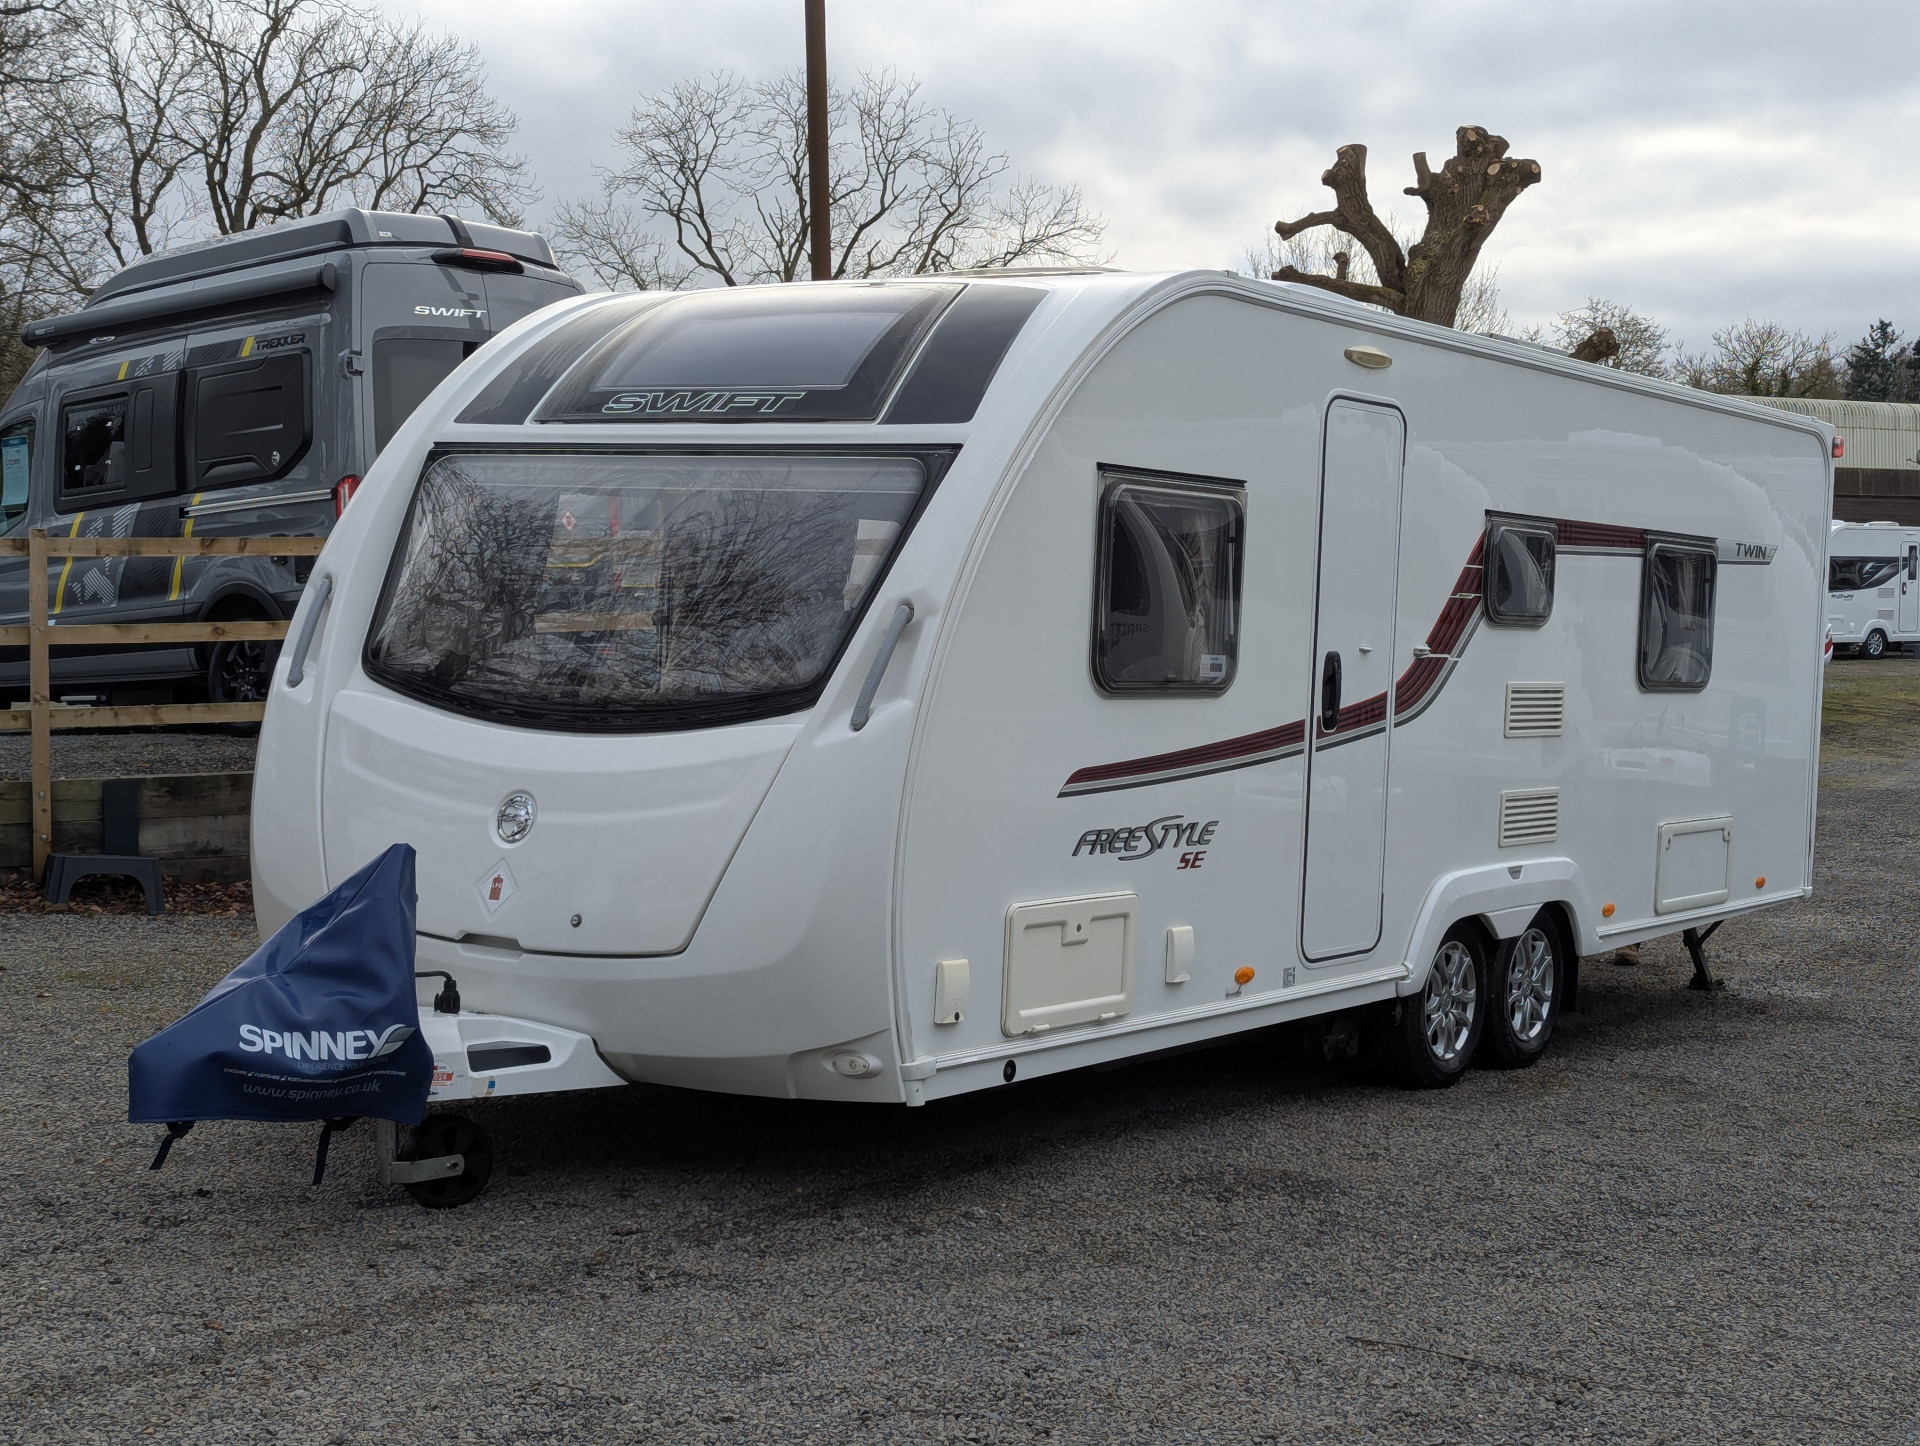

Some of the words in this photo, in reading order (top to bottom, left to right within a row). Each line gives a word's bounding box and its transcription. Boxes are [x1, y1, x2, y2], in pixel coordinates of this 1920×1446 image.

[413, 305, 487, 318] SWIFT
[256, 333, 305, 351] TREKKER
[602, 391, 808, 413] SWIFT
[1735, 542, 1767, 560] TWIN
[1072, 815, 1219, 861] FREESTYLE
[1177, 851, 1207, 870] SE
[239, 1024, 411, 1061] SPINNEY
[297, 1061, 344, 1071] EXPERIENCE
[243, 1079, 381, 1103] www.spinney.co.uk
